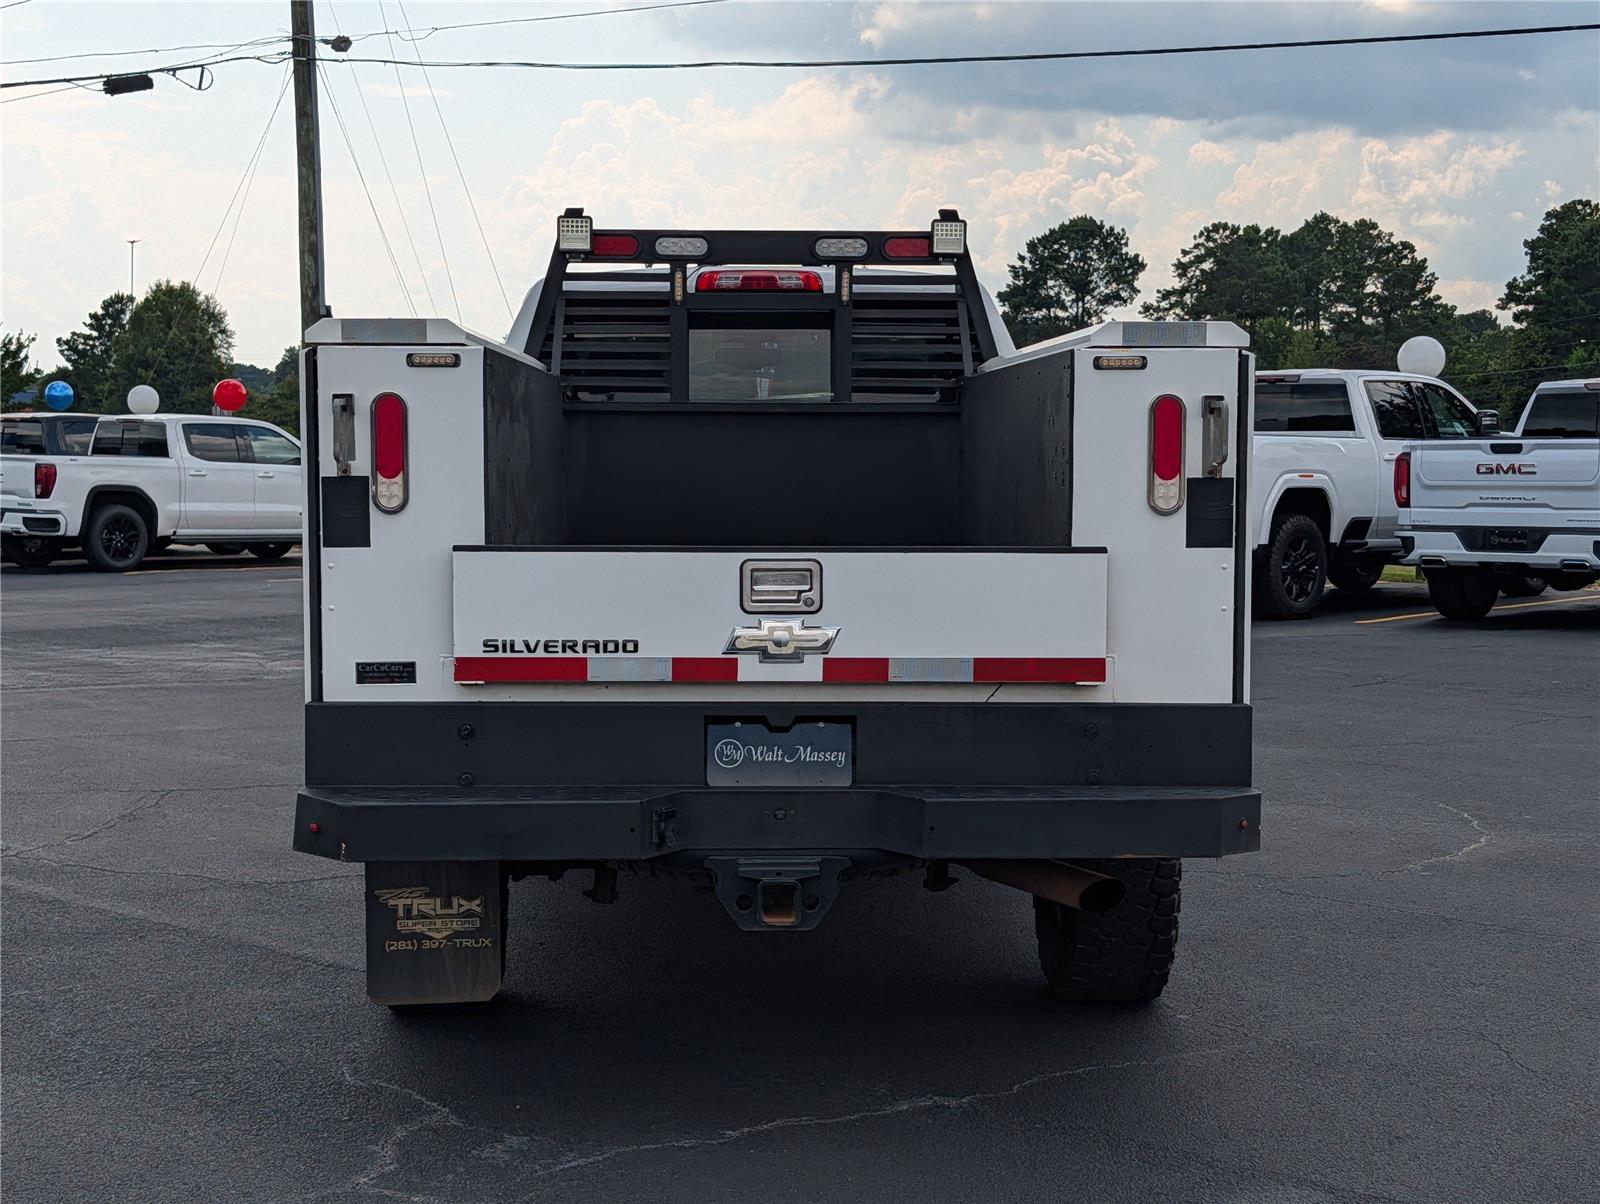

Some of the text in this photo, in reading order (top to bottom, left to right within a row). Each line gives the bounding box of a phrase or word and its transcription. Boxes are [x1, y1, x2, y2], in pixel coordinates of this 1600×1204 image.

[1475, 463, 1537, 476] GMC
[482, 638, 639, 654] SILVERADO
[744, 745, 846, 768] Walt Massey
[387, 896, 484, 919] TRUX
[398, 919, 479, 929] SUPER STORE
[385, 938, 492, 953] (281) 397-TRUX
